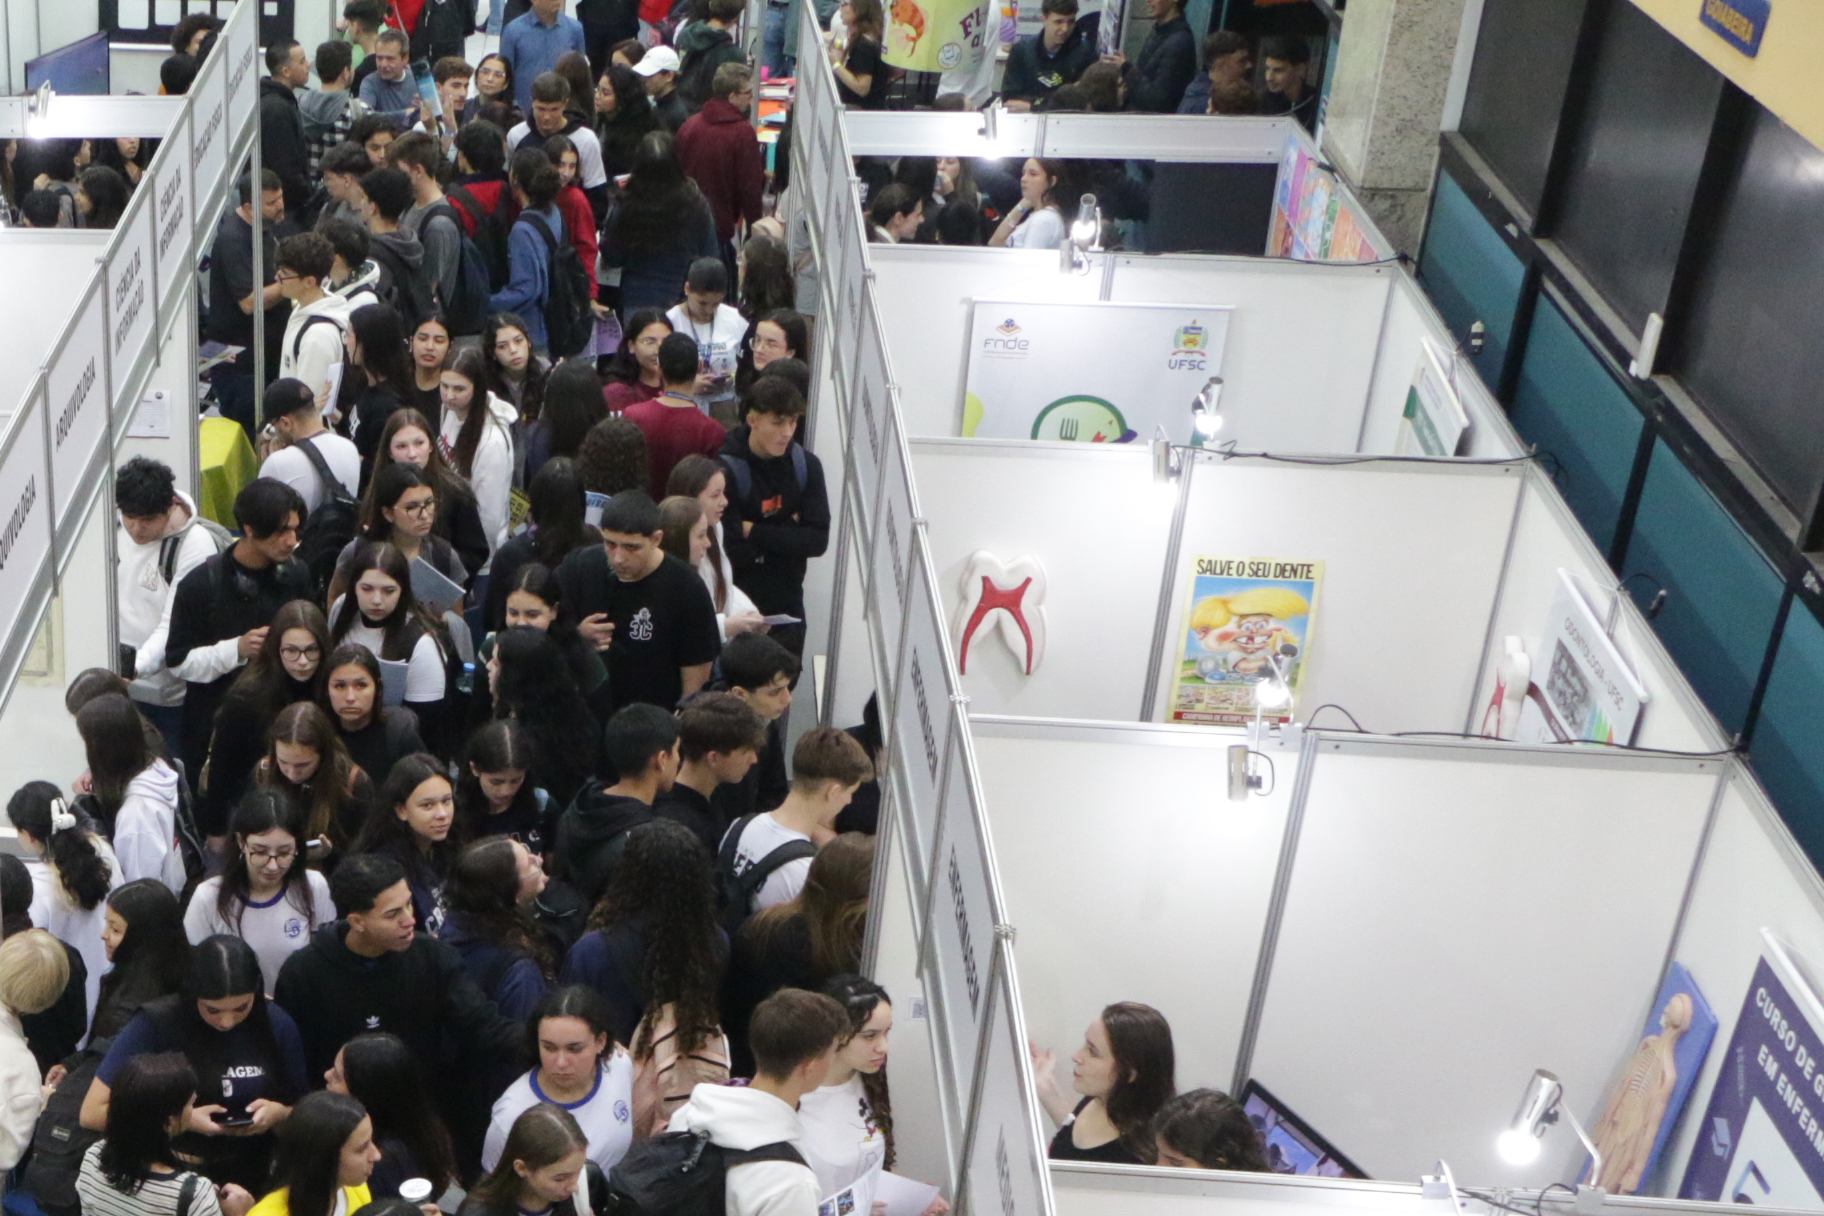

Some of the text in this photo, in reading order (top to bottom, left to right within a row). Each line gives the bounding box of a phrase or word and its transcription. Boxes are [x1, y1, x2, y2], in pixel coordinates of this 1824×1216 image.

[159, 194, 184, 264] INFORMAÇÃO
[160, 180, 175, 222] CIÊNCIA
[116, 245, 142, 313] CIÊNCIA DA
[114, 279, 145, 357] INFORMAÇÃO
[1168, 359, 1207, 371] UFSC
[56, 356, 96, 453] ARQUIVOLOGIA
[1197, 558, 1315, 580] SALVE O SEU DENTE
[1564, 616, 1605, 684] ODONTOLOGIA
[911, 644, 938, 790] ENFERMAGEM
[947, 842, 980, 1024] ENFERMAGEM
[1755, 986, 1798, 1052] CURSO
[1795, 1045, 1814, 1081] DE
[1757, 1044, 1776, 1083] EM
